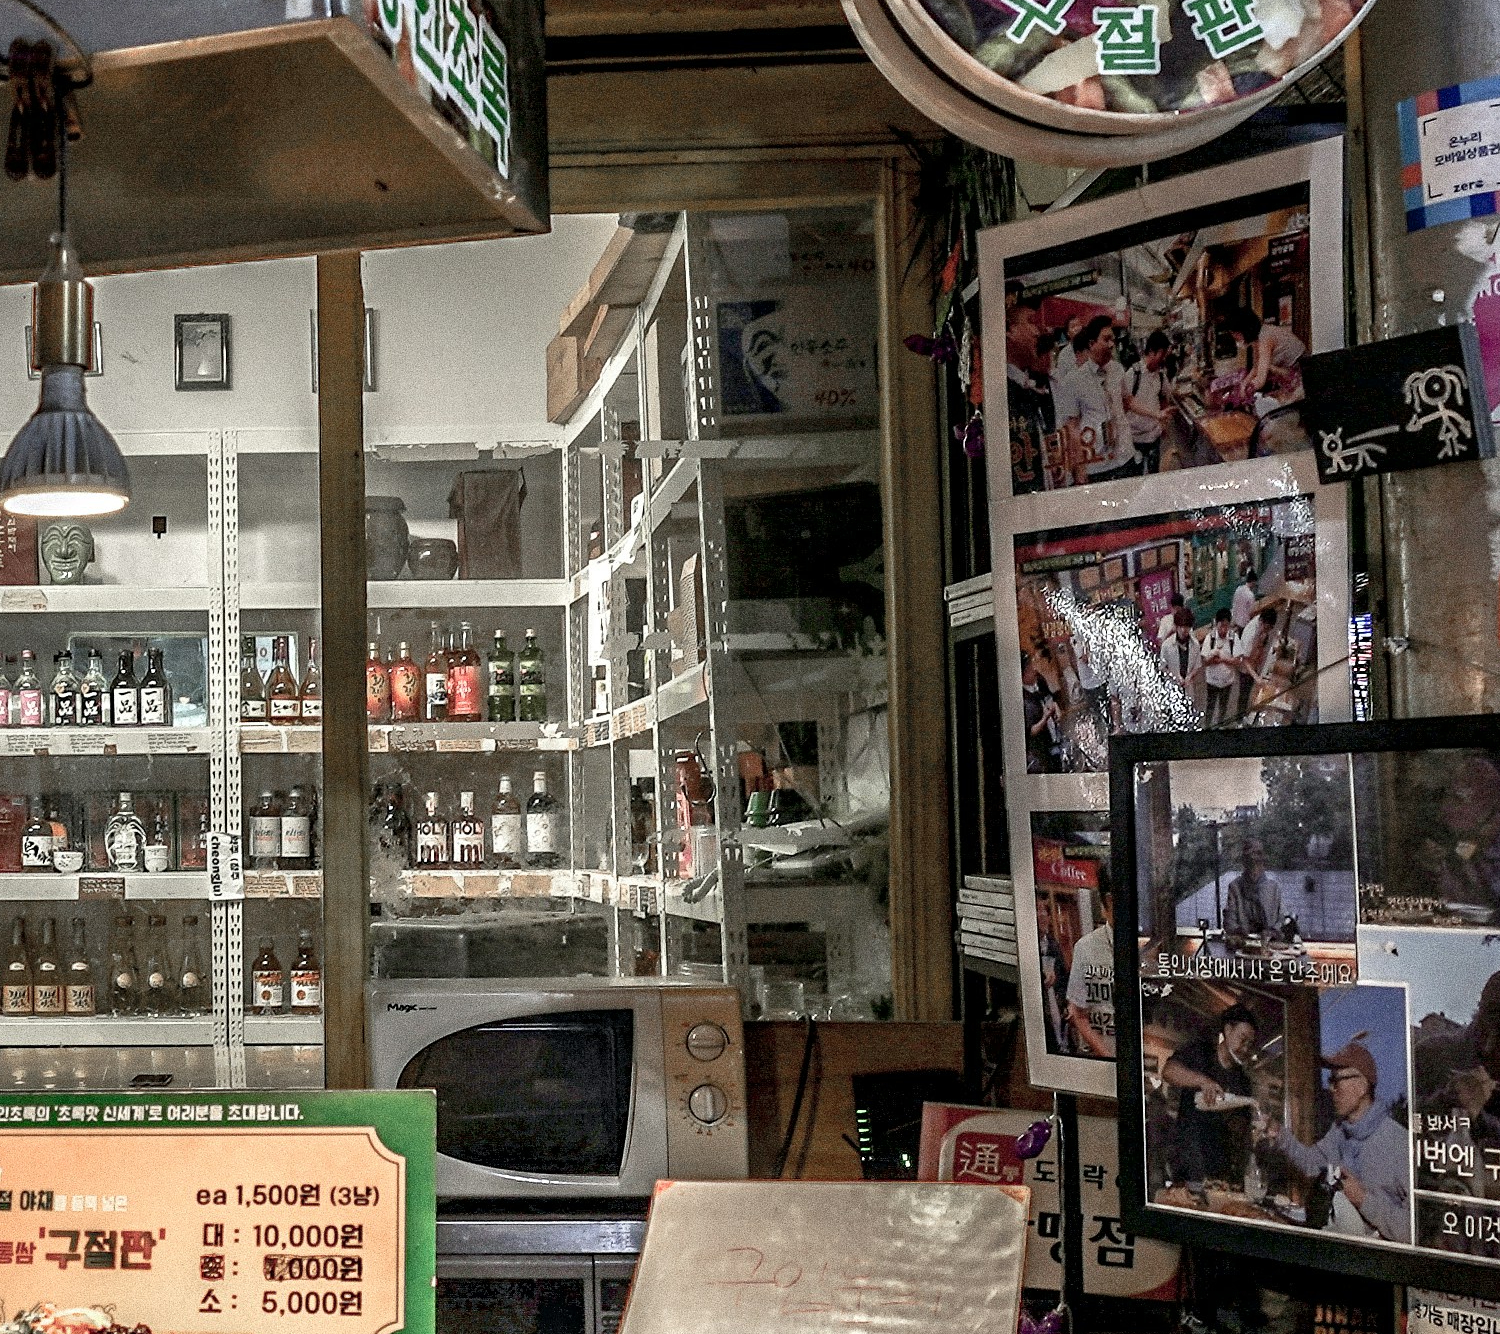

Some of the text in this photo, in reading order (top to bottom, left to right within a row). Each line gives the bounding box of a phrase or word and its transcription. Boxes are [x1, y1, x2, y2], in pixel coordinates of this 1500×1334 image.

[1449, 131, 1482, 148] 온누리
[1434, 143, 1500, 167] 모바일상품권
[1157, 953, 1244, 980] 통인시장에서
[1270, 960, 1284, 982] 온
[227, 1103, 304, 1121] 초대합니다.
[959, 1138, 1000, 1182] 通
[196, 1183, 380, 1208] ea 1,500원 (3냥)
[1443, 1211, 1460, 1236] 오
[253, 1224, 364, 1250] 10,000원
[261, 1290, 363, 1317] 5,000원
